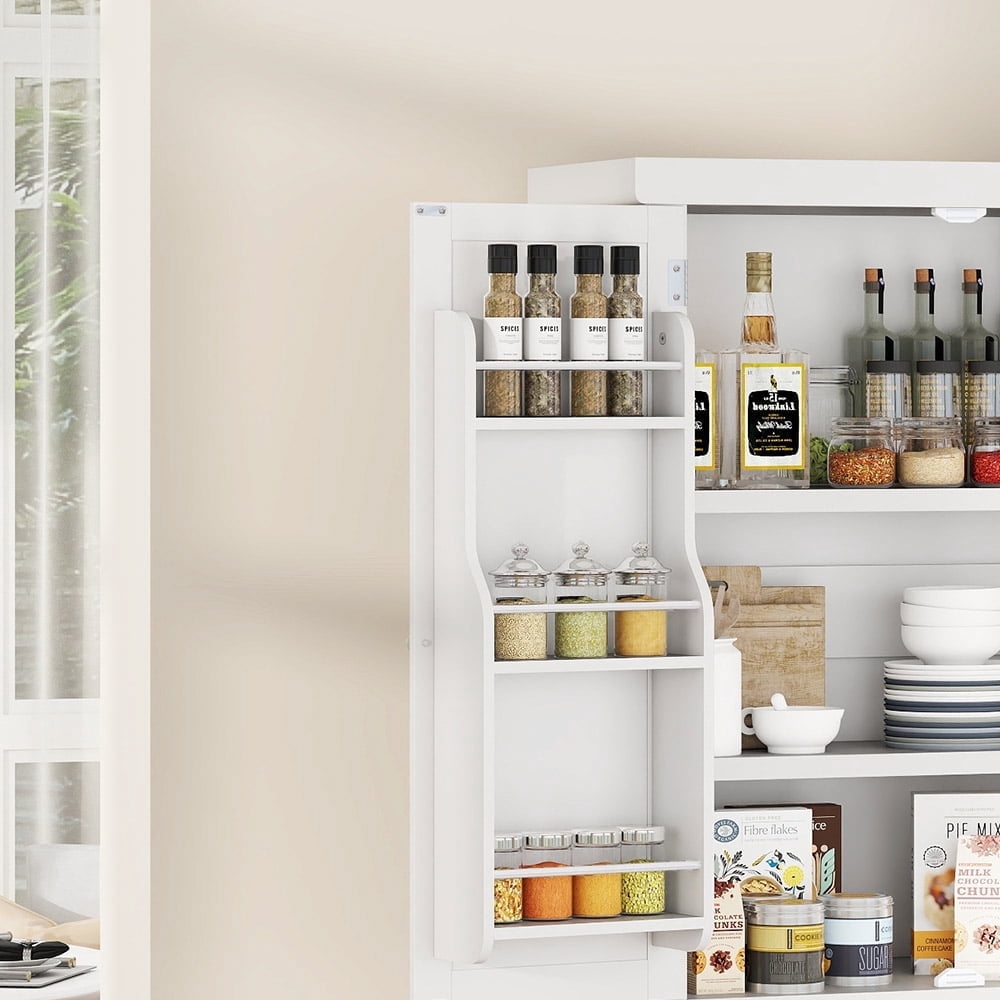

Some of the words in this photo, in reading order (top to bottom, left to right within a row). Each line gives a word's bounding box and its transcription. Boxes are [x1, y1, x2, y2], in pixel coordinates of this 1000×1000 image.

[744, 824, 769, 836] Fibre
[770, 823, 799, 835] flakes
[713, 921, 744, 929] UNKS
[858, 945, 889, 971] SUGAR
